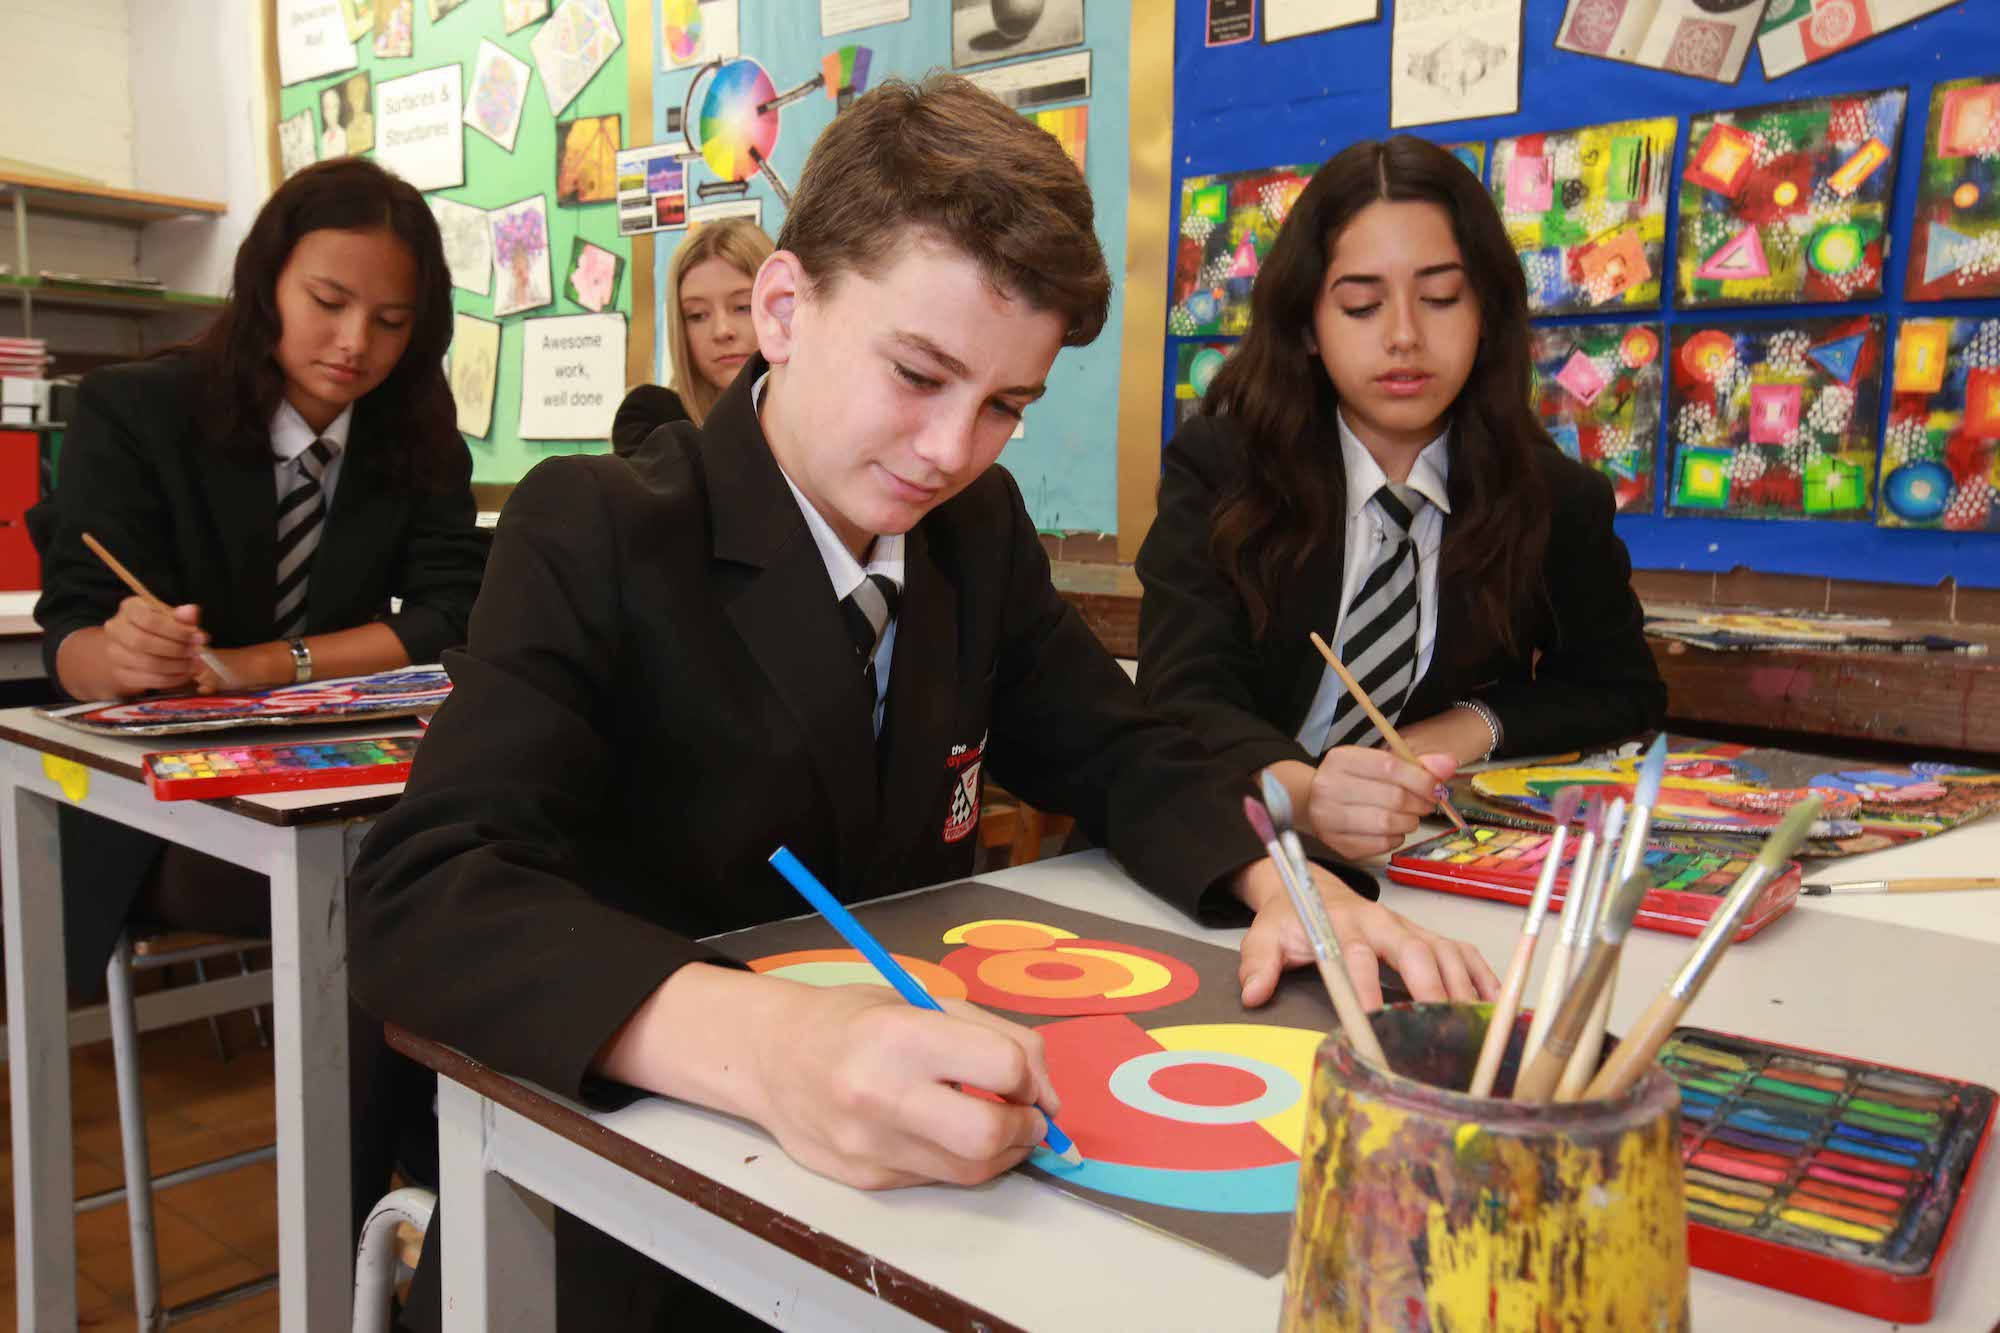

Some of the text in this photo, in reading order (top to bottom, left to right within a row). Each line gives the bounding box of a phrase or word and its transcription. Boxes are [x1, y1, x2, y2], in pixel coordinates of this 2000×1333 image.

[385, 91, 435, 115] Surfaces
[385, 123, 449, 148] Structures
[542, 335, 602, 351] Awesome
[555, 362, 590, 379] work,
[544, 391, 603, 407] well done
[951, 744, 967, 756] the
